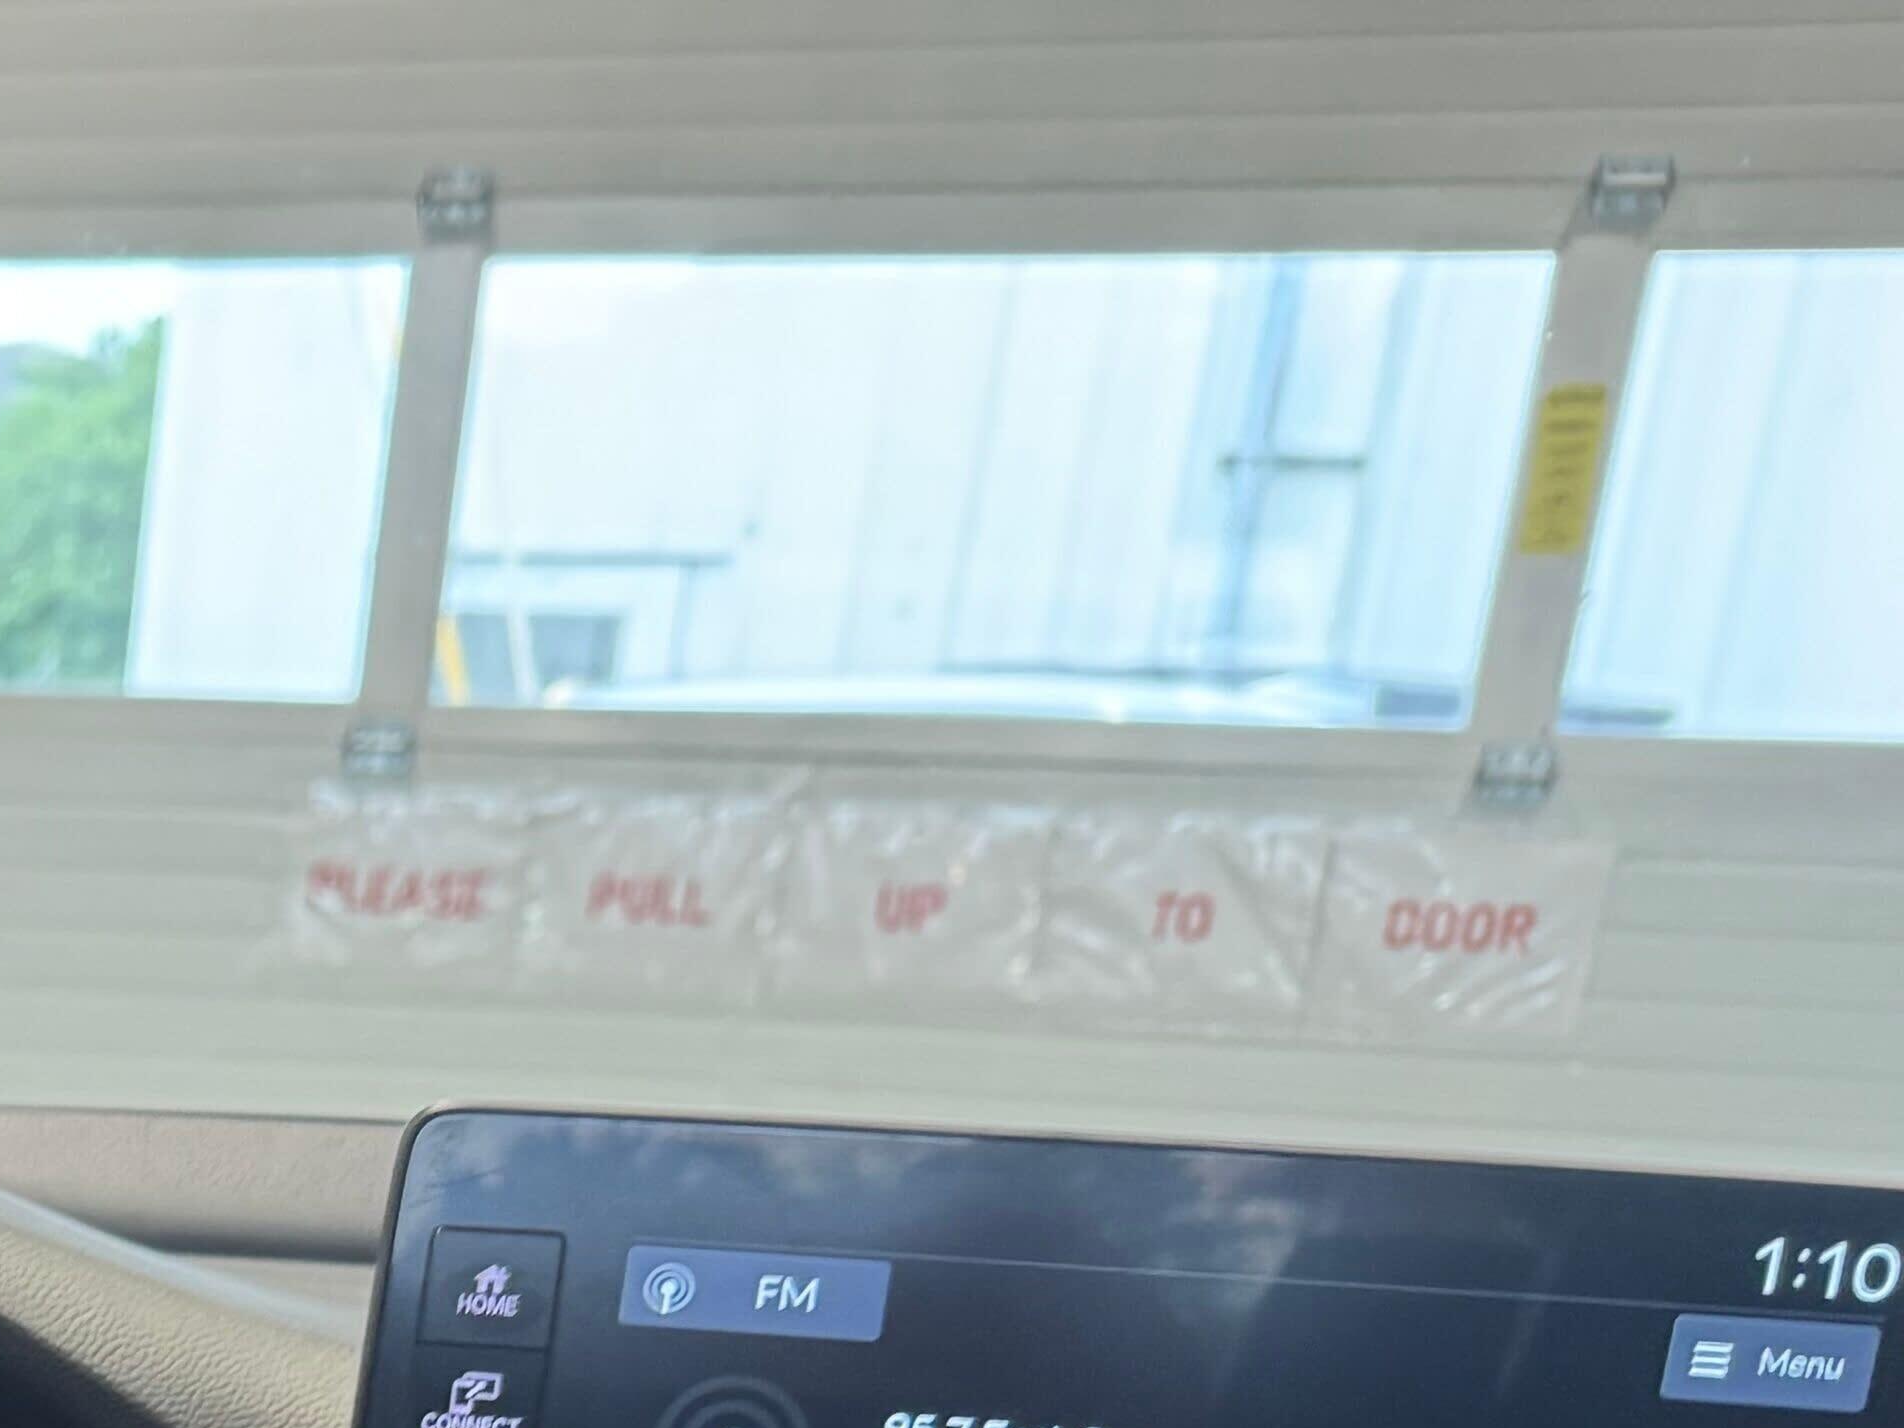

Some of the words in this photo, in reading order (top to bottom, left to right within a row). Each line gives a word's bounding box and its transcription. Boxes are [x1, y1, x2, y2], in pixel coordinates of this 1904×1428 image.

[309, 857, 489, 922] PLEASE
[585, 868, 711, 928] PULL
[874, 883, 948, 935] UP
[1152, 890, 1215, 945] TO
[1381, 896, 1539, 956] DOOR
[1753, 1235, 1903, 1304] 1:10
[456, 1292, 521, 1319] HOME
[753, 1274, 821, 1314] FM
[1757, 1345, 1846, 1383] Menu
